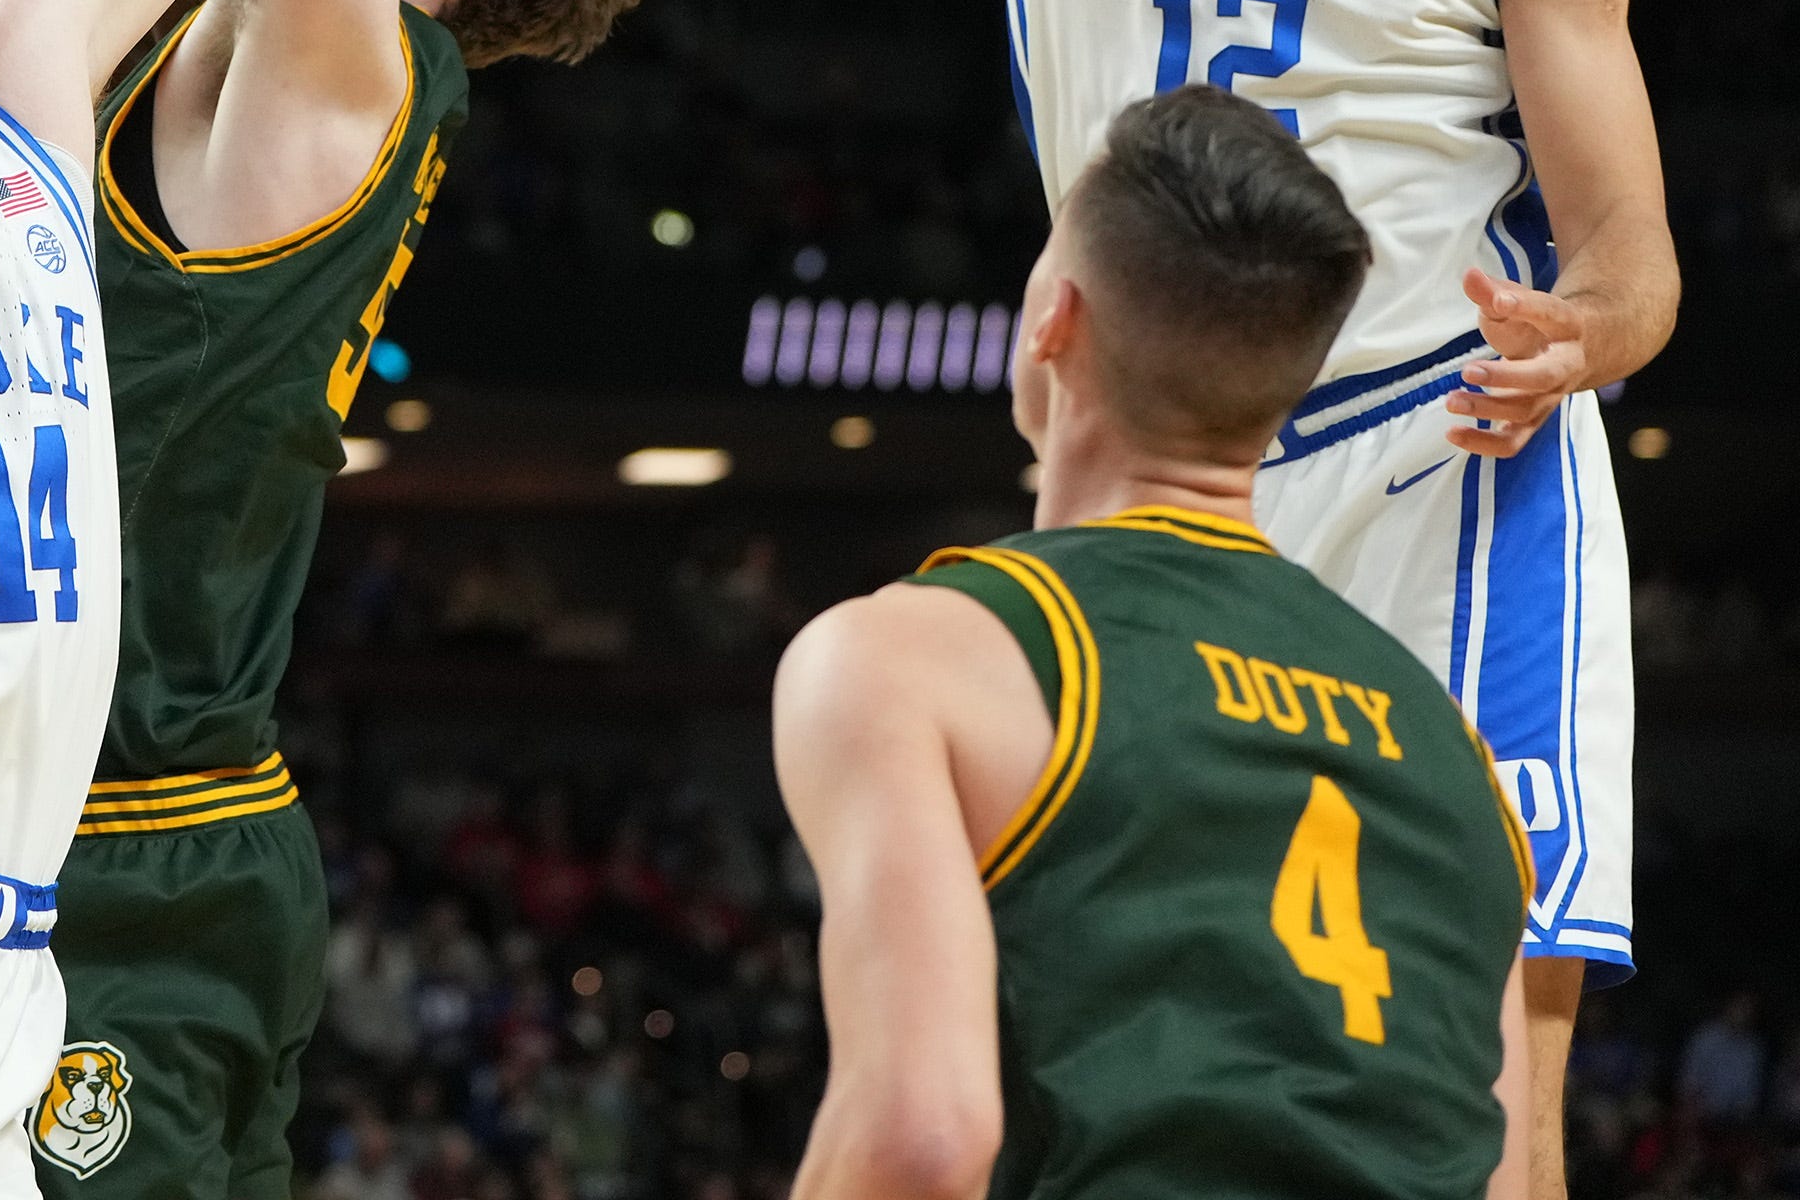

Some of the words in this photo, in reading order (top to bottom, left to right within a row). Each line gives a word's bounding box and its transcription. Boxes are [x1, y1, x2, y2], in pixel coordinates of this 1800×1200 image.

[35, 238, 60, 253] ACC
[1194, 640, 1403, 761] DOTY
[1270, 773, 1393, 1045] 4
